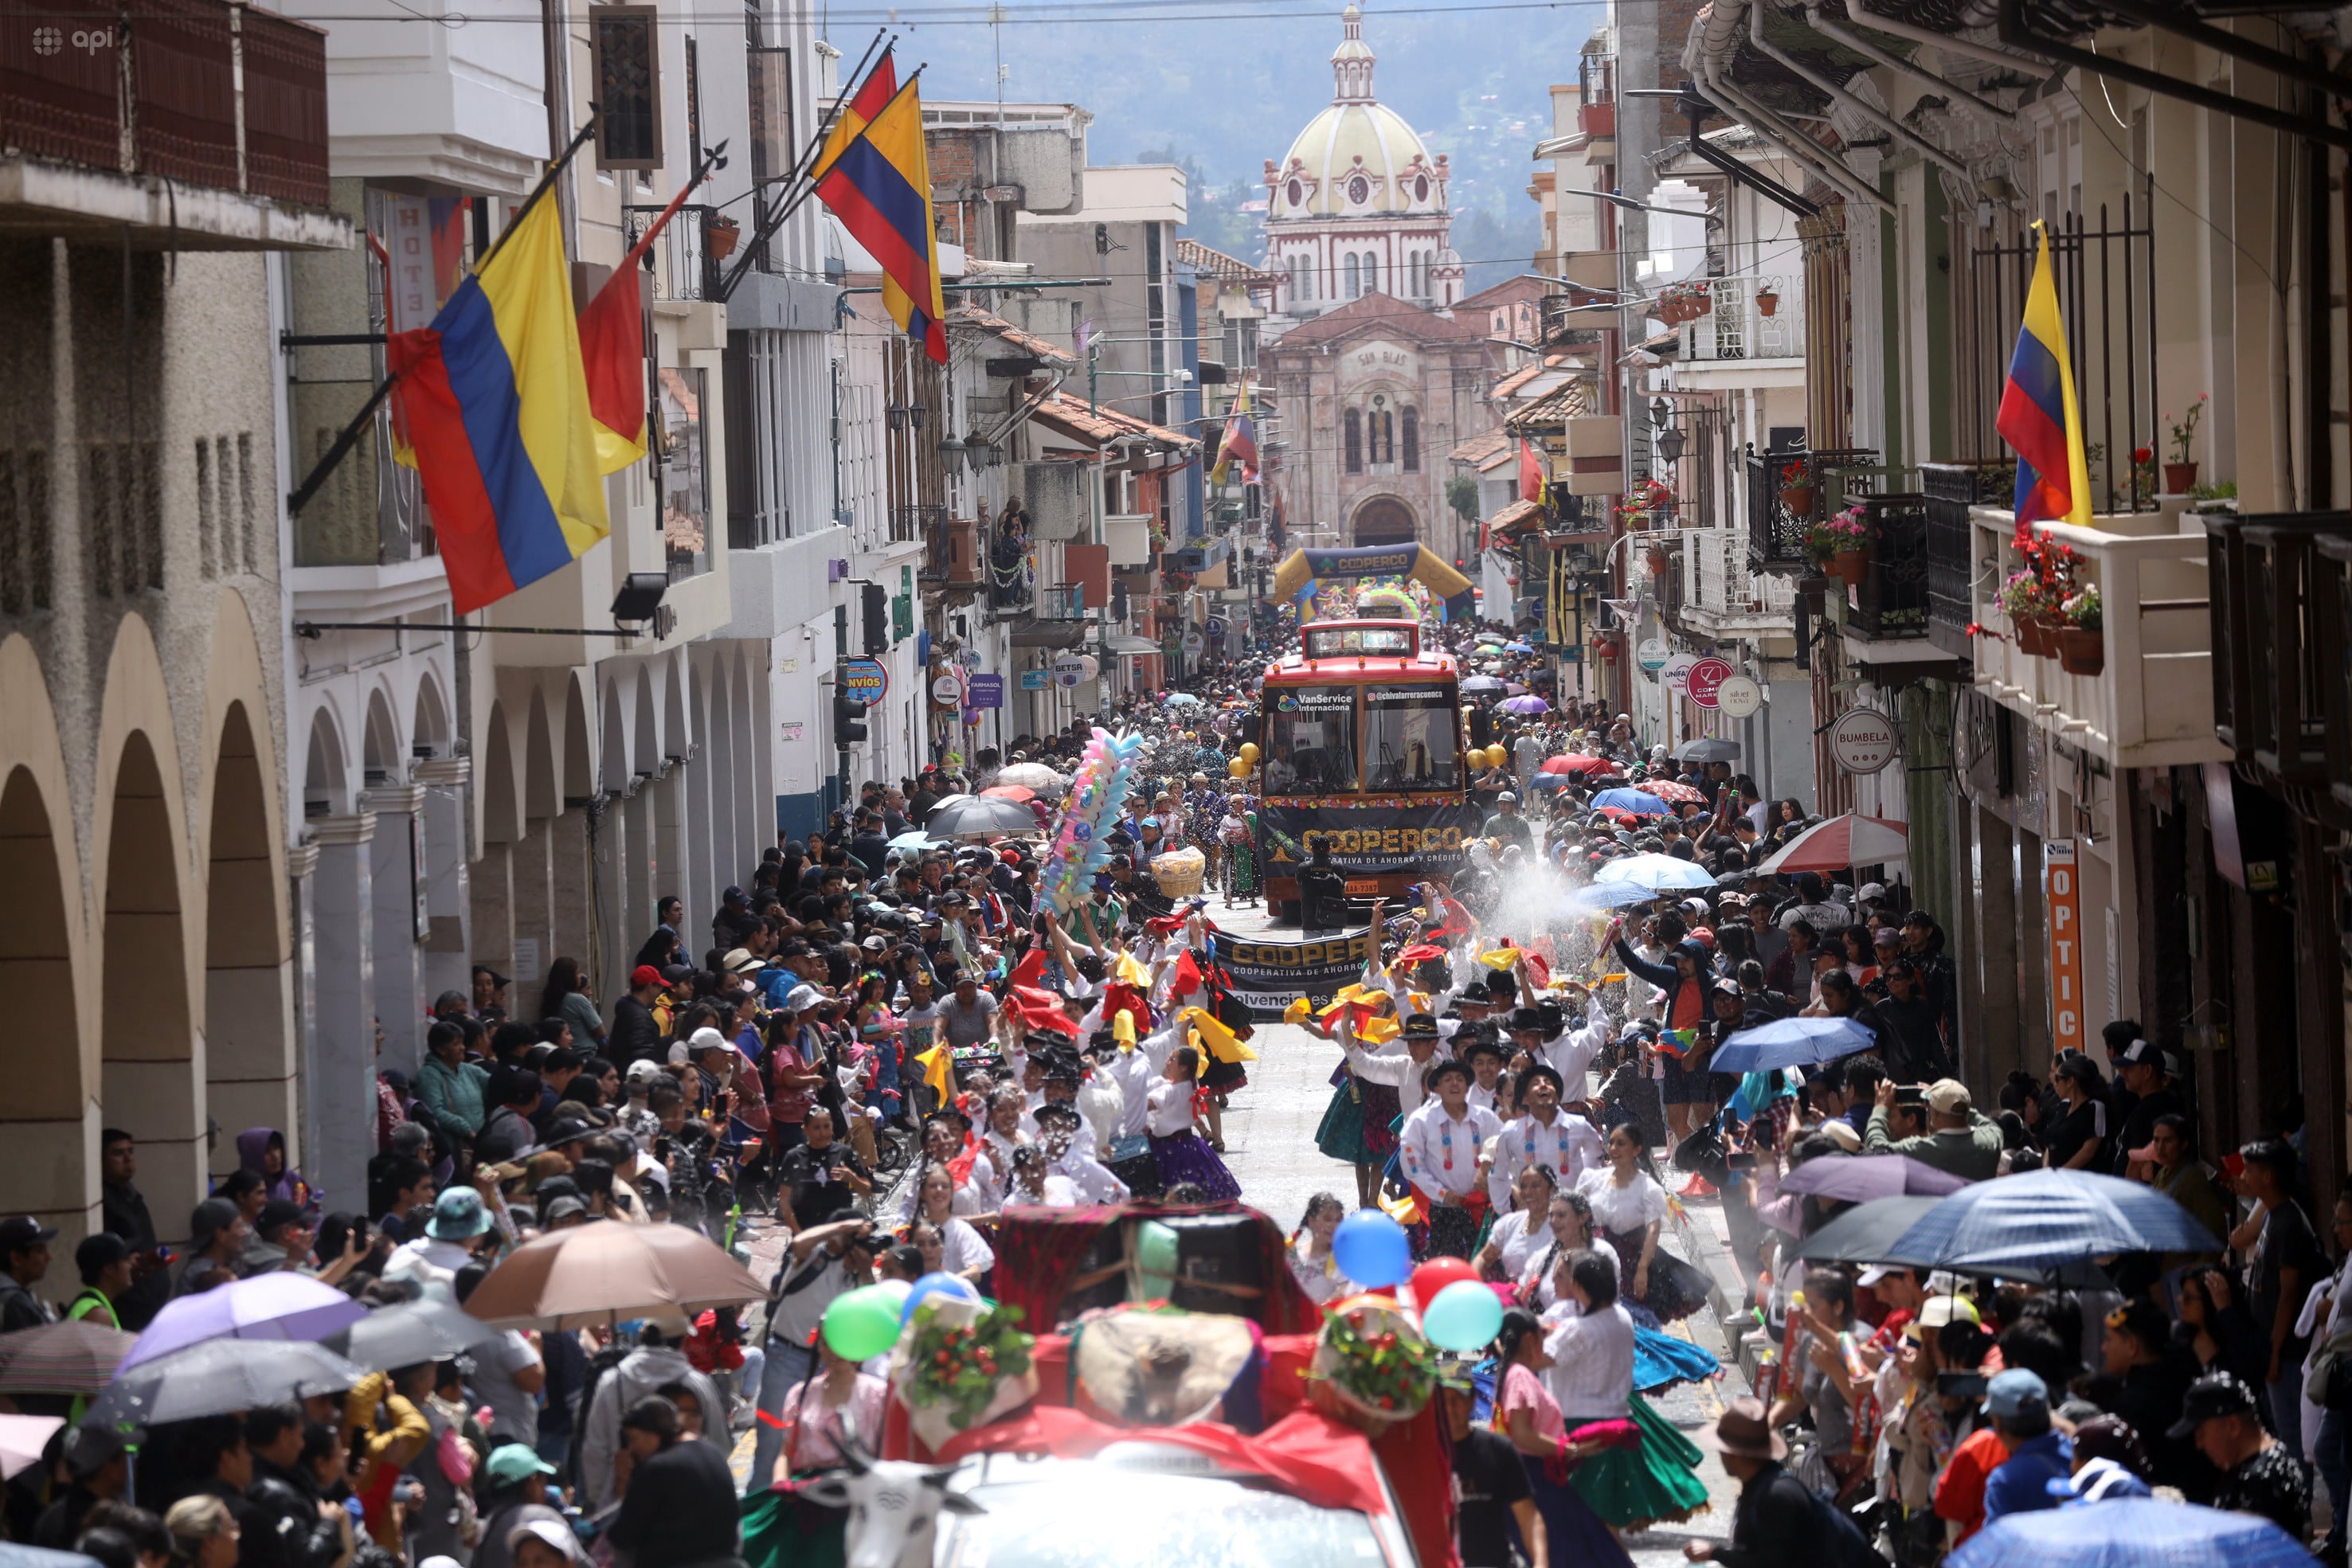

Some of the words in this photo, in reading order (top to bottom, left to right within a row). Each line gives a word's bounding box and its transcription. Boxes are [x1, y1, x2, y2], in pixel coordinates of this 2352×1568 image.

[1358, 351, 1376, 366] SAN
[1383, 350, 1407, 366] BLAS
[1338, 554, 1407, 570] COOPERCO
[847, 676, 881, 687] NVÍOS
[1298, 694, 1352, 704] VanService
[1840, 733, 1889, 743] BUMBELA
[1302, 826, 1462, 854] COOPERCO
[1304, 856, 1362, 865] CORATIVA
[1427, 853, 1462, 862] CRÉDITO
[1232, 936, 1368, 967] COOPER
[2053, 870, 2076, 1053] OPTIC
[1234, 966, 1301, 976] COOPERATIVA
[1324, 962, 1363, 975] AHORRO
[1235, 993, 1301, 1007] olvenci
[1311, 995, 1329, 1006] es
